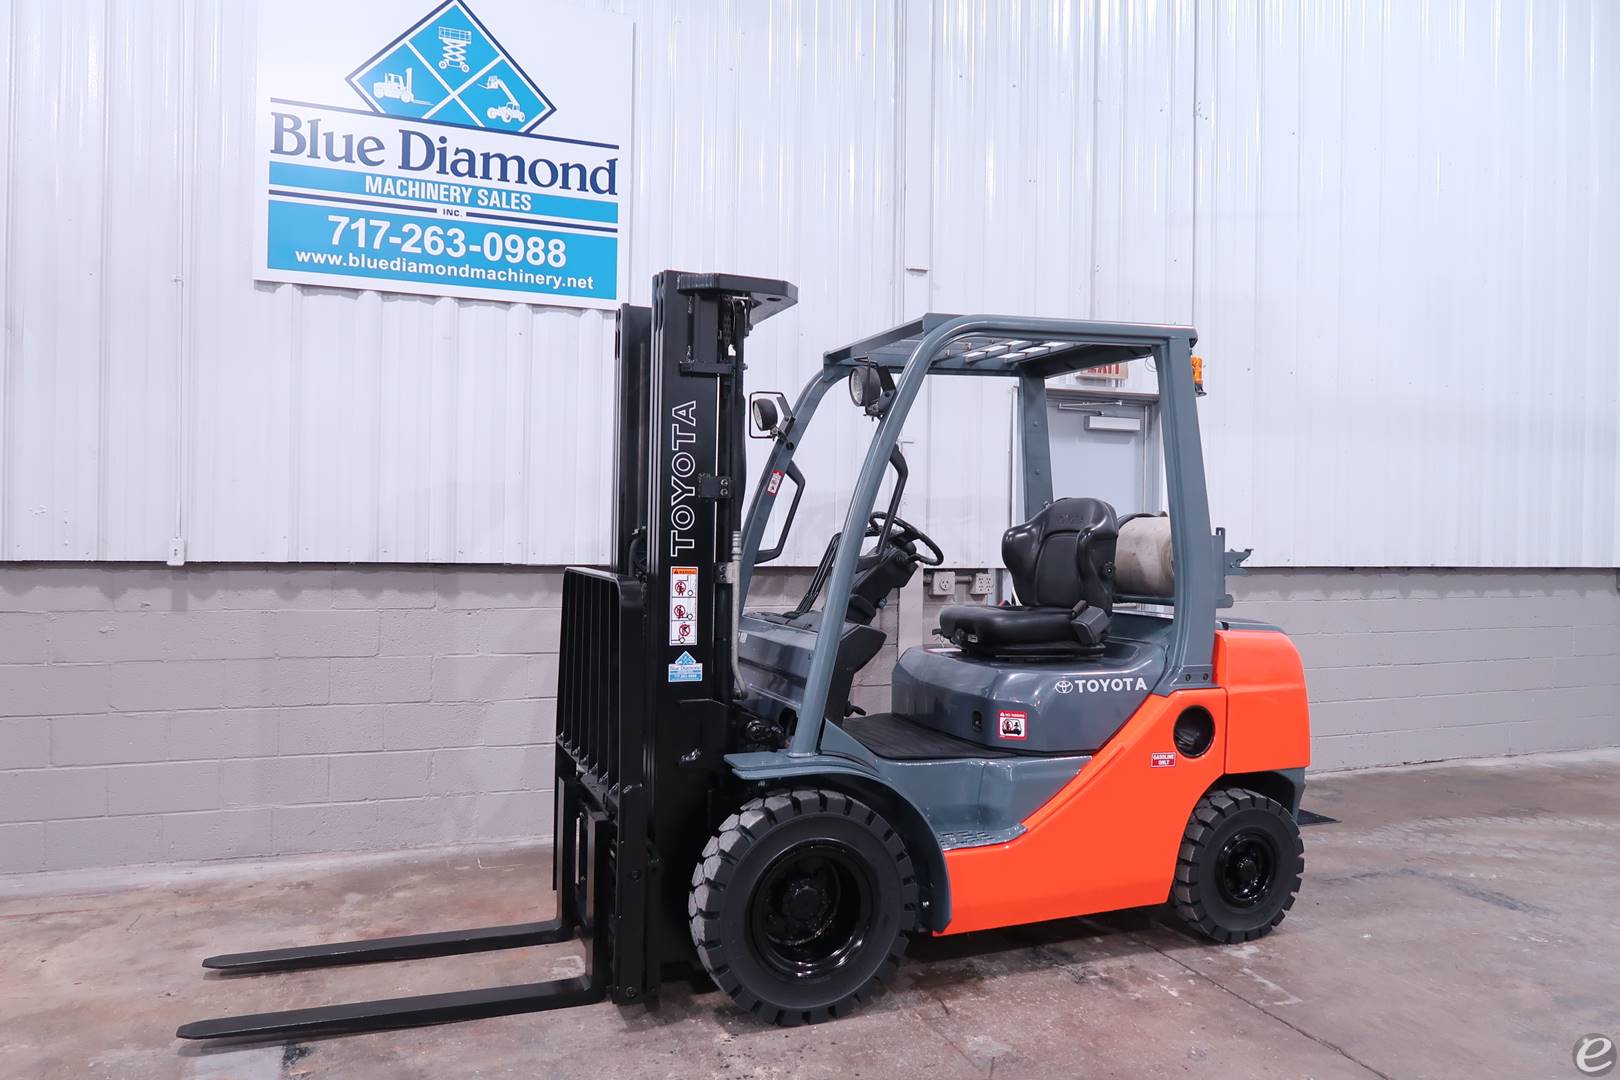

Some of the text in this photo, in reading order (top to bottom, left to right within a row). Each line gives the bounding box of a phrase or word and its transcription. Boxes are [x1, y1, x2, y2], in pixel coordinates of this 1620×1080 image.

[270, 112, 618, 196] Blue Diamond
[365, 175, 532, 211] MACHINERY SALES
[442, 208, 463, 218] INC.
[328, 214, 567, 268] 717-263-0988
[295, 250, 594, 290] www.bluediamondmachinery.net
[671, 400, 696, 557] TOYOTA
[1075, 677, 1148, 693] TOYOTA
